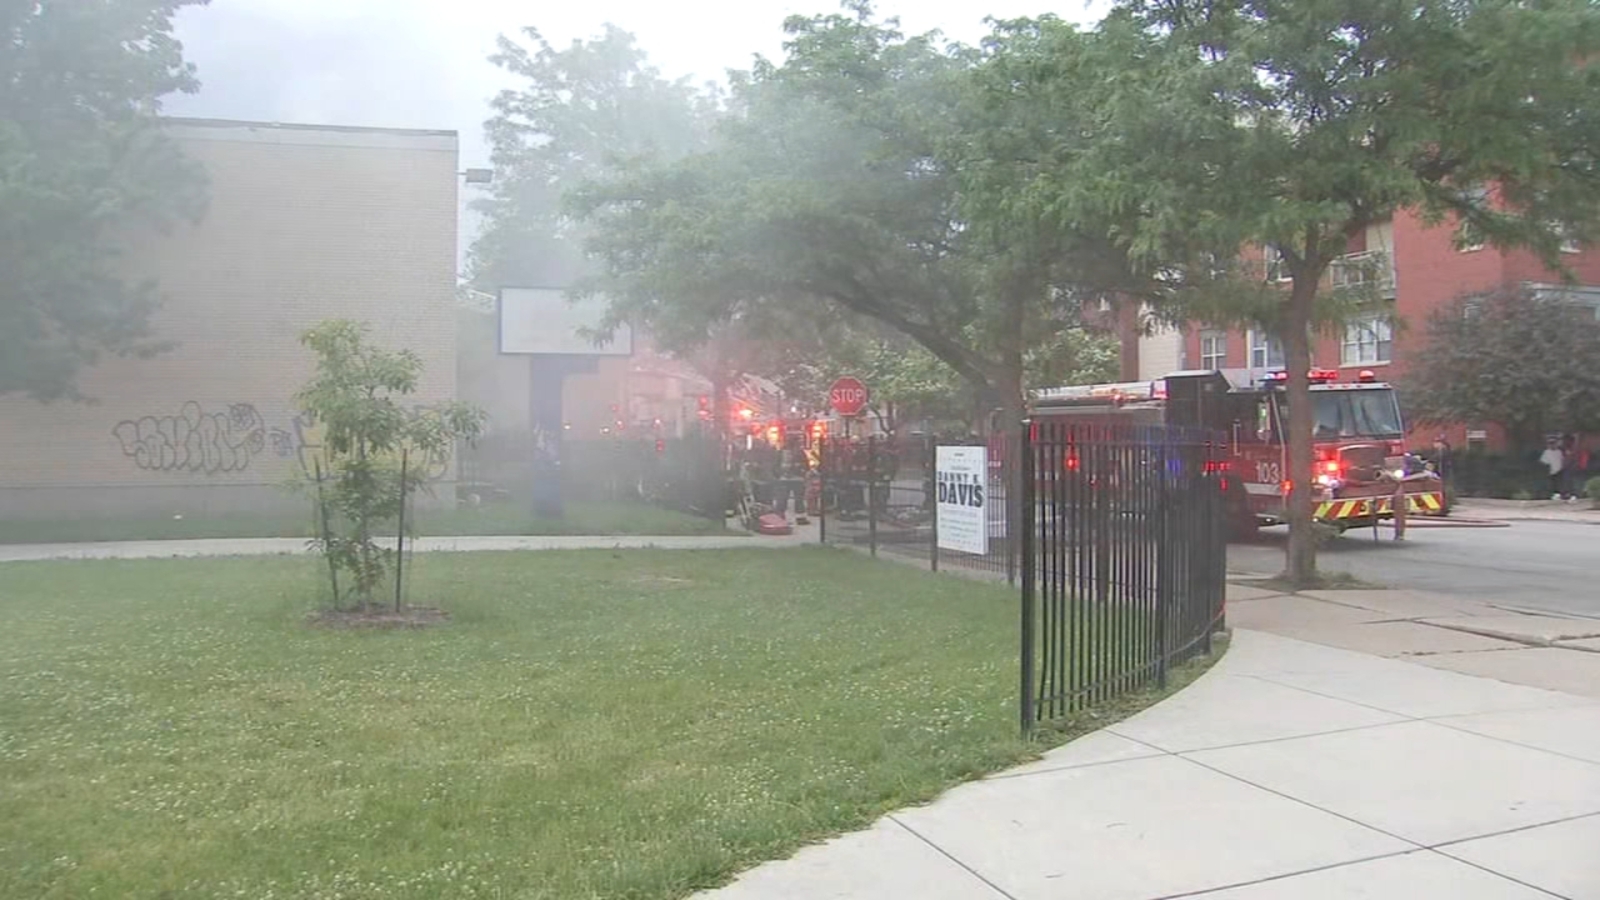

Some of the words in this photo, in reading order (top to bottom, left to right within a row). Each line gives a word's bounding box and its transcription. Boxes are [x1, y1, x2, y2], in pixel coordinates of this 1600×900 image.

[832, 388, 864, 403] STOP
[1255, 461, 1279, 484] 103
[938, 482, 984, 508] DAVIS
